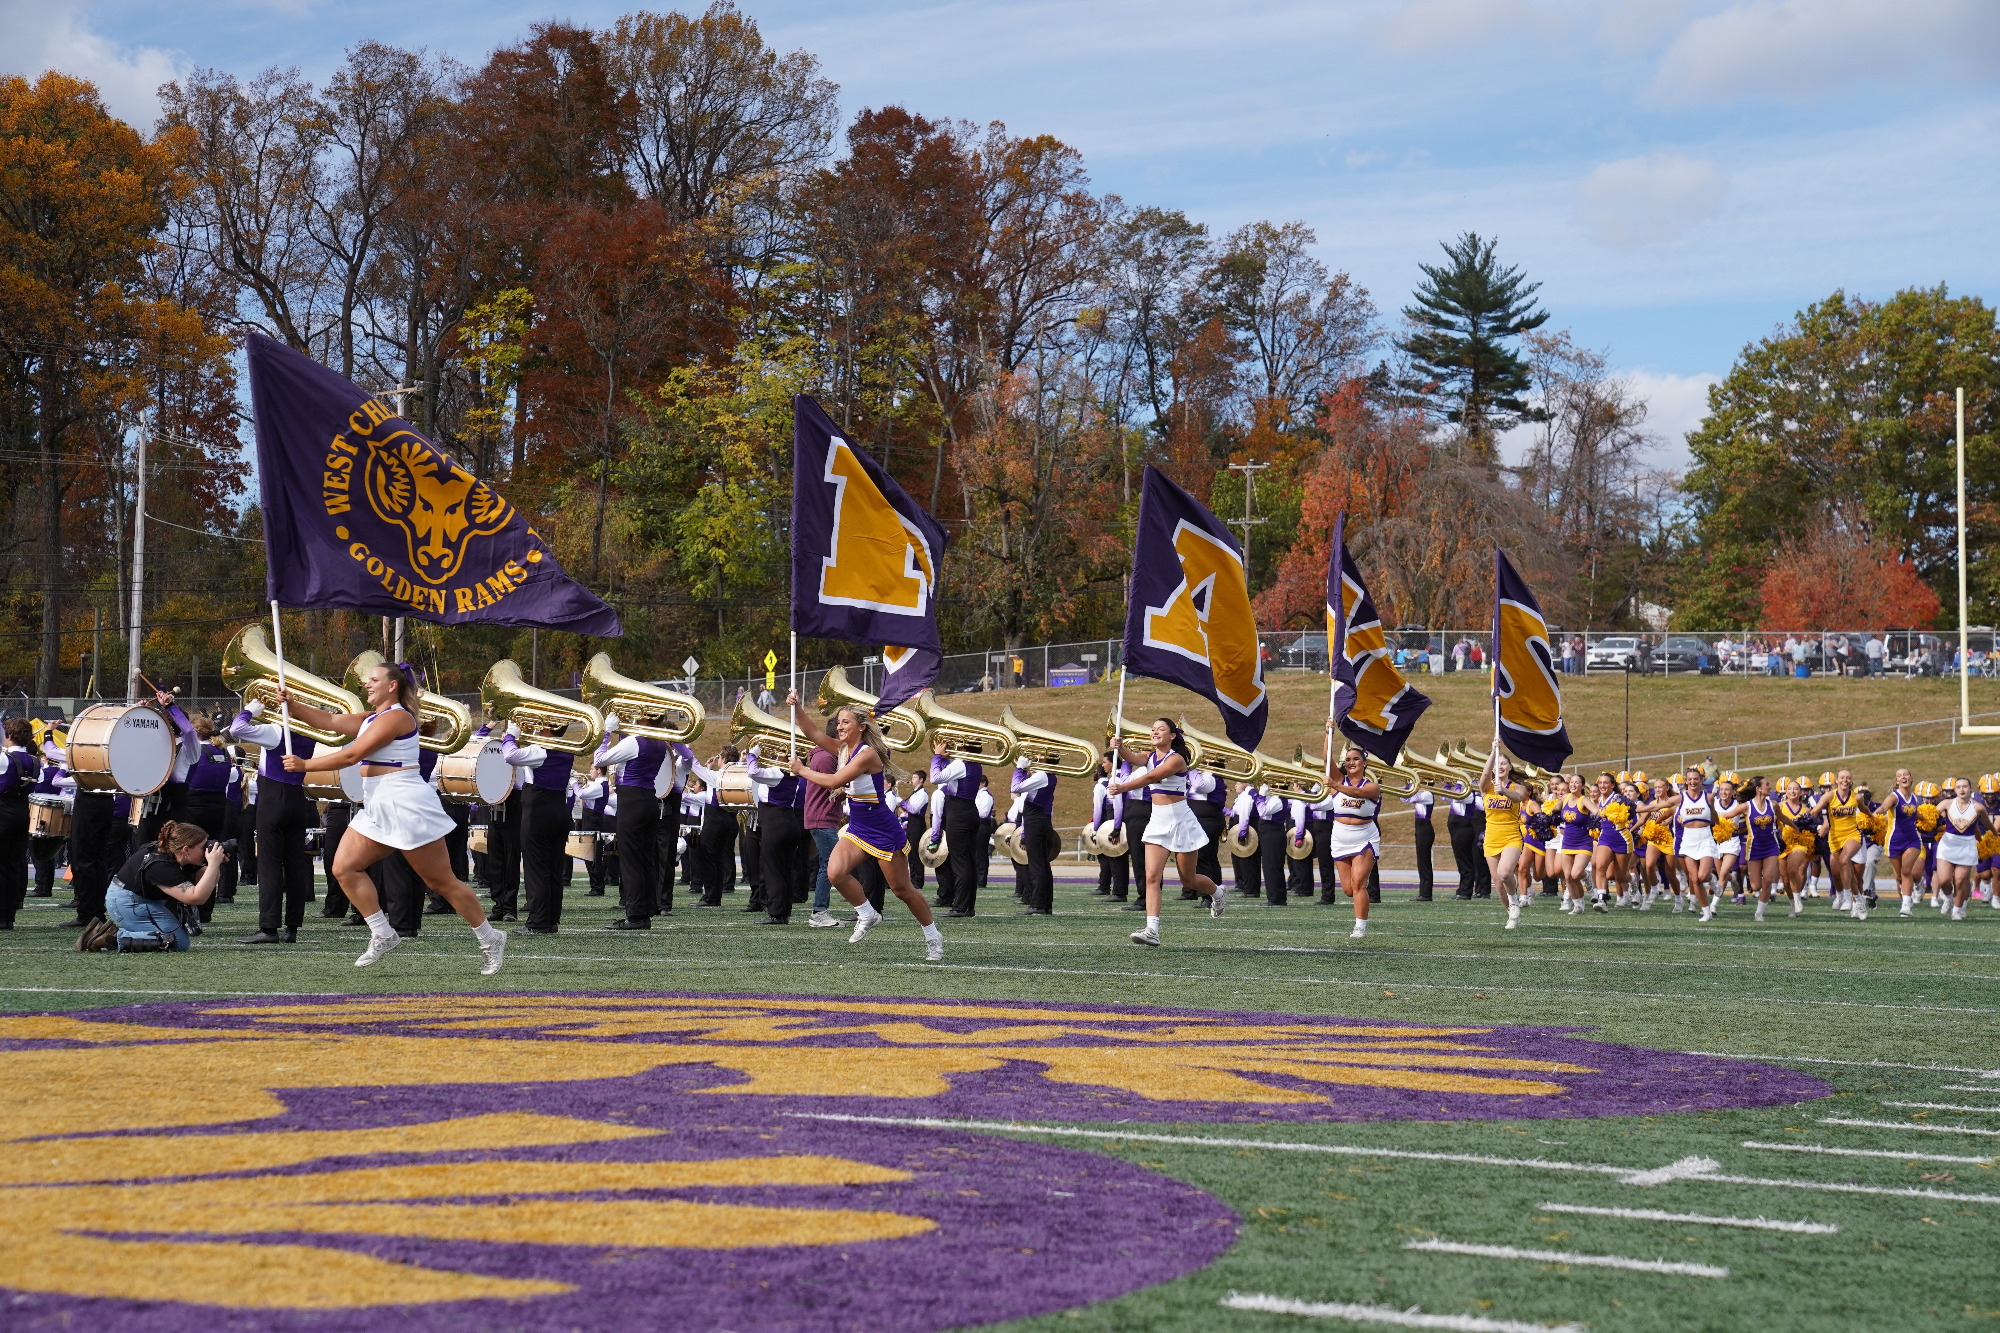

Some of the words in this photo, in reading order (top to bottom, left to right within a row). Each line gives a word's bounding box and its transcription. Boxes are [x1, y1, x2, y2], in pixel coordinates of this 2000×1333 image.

[323, 434, 360, 515] WEST
[349, 542, 447, 614] GOLDEN
[455, 560, 528, 613] RAMS
[132, 718, 159, 729] YAMAHA
[1487, 798, 1513, 810] WCU
[1831, 806, 1857, 817] WCU
